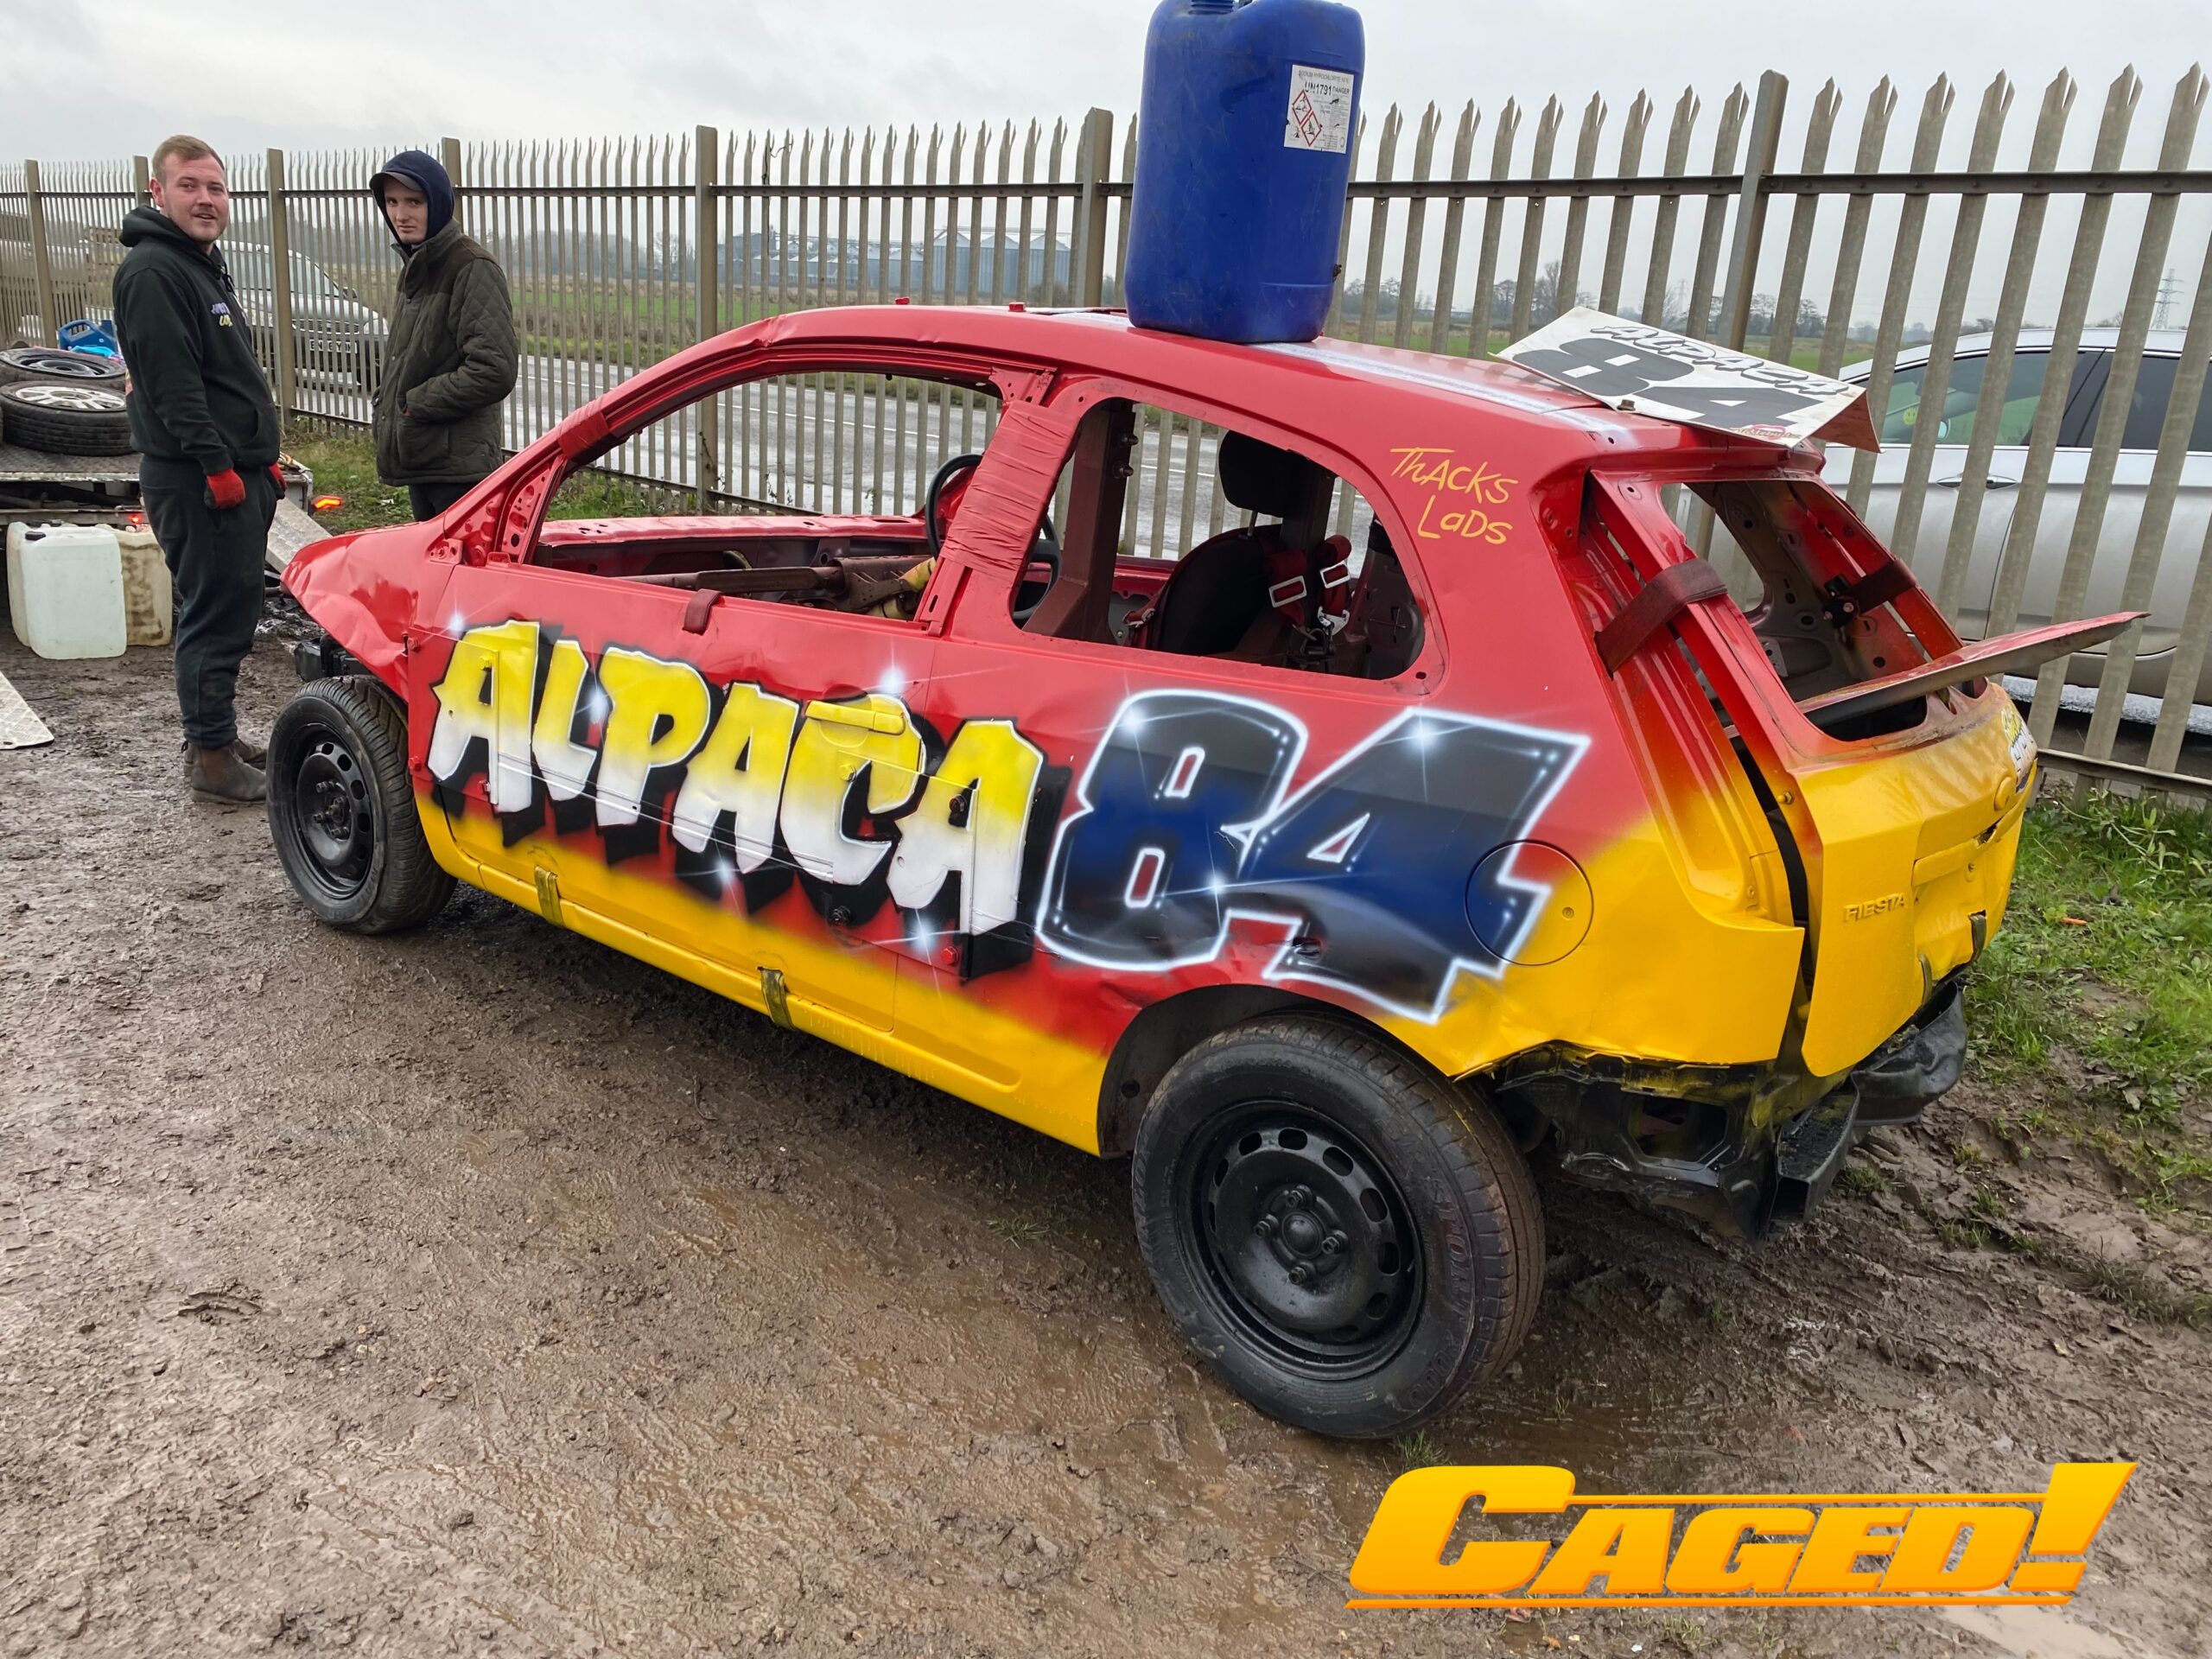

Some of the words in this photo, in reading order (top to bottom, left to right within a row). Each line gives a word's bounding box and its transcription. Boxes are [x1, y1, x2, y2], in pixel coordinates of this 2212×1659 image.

[1305, 81, 1332, 96] UN1791
[1332, 86, 1350, 95] DANGER
[1513, 338, 1825, 429] 84
[1590, 325, 1849, 396] ALPACA
[428, 620, 1044, 937] ALPACA
[1034, 689, 1592, 1025] 84
[1842, 892, 1905, 923] FIESTA
